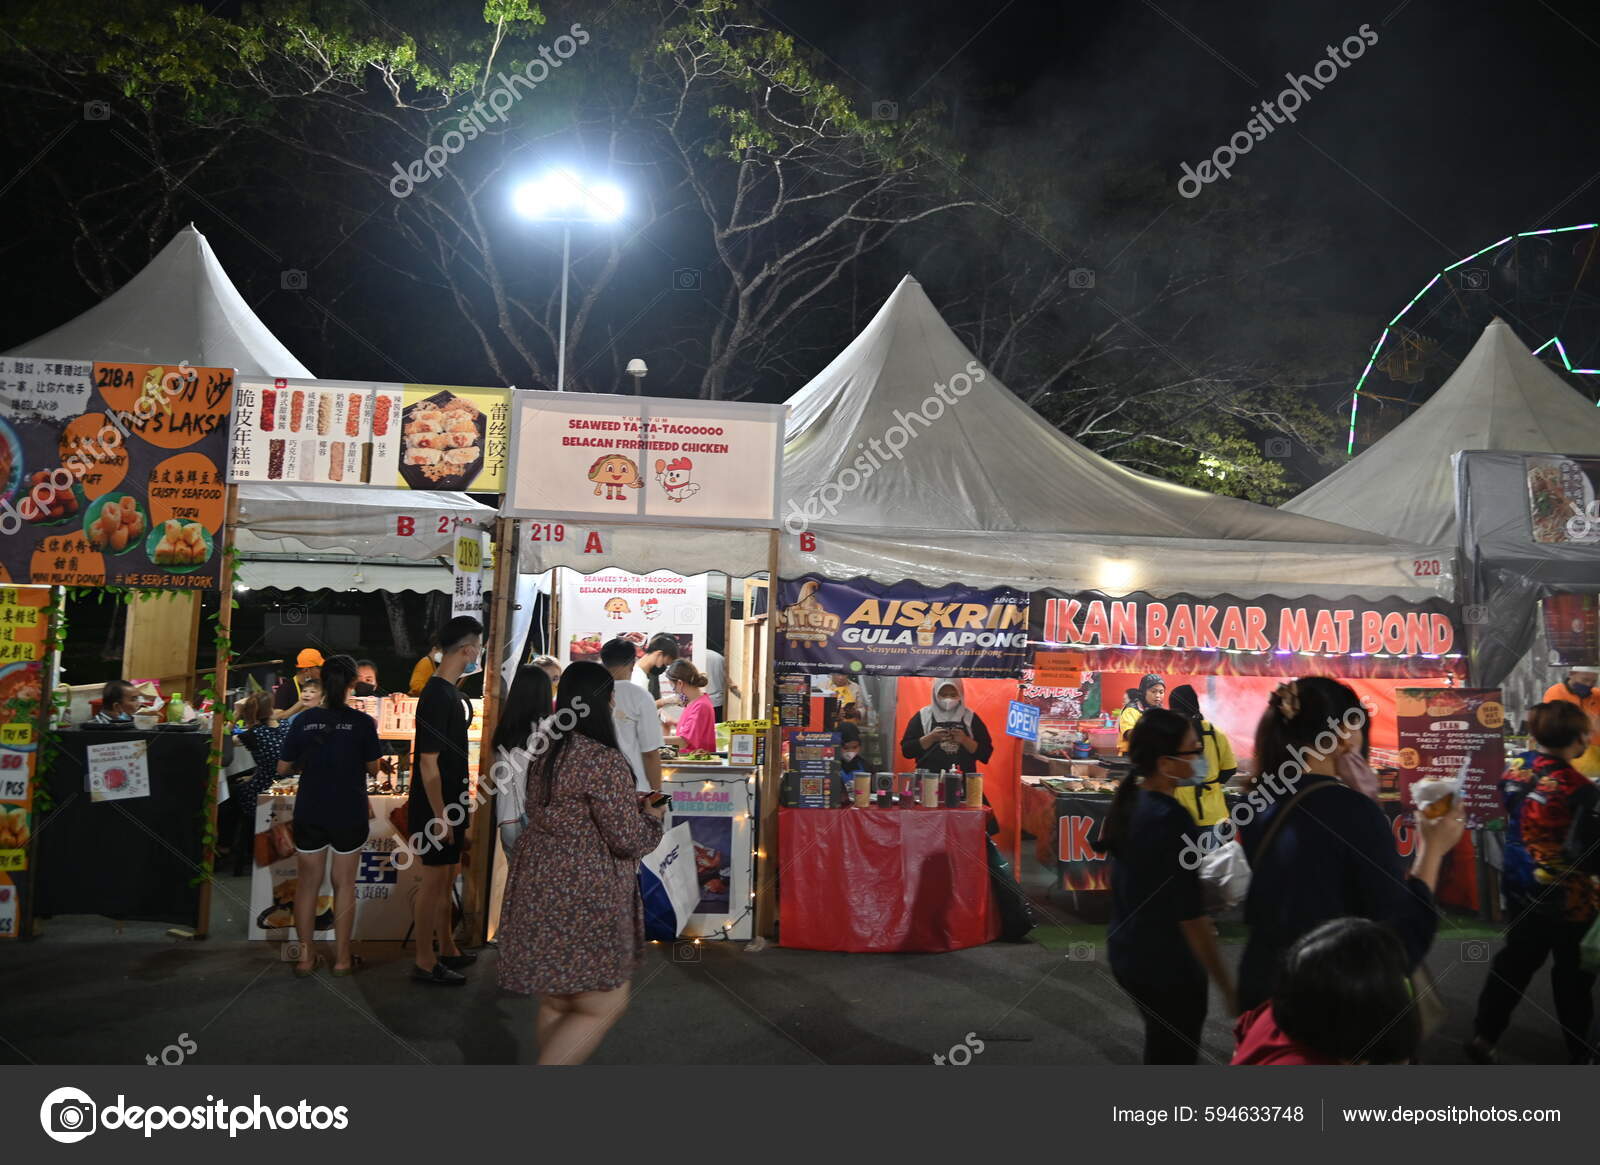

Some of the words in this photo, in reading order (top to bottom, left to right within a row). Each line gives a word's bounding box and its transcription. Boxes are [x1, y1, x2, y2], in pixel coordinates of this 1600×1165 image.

[169, 412, 228, 436] LAKSA
[232, 388, 256, 465] 脆皮年糕
[569, 419, 621, 432] SEAWEED
[562, 436, 614, 448] BELACAN
[681, 443, 729, 455] CHICKEN
[152, 487, 181, 499] CRISPY
[182, 488, 222, 500] SEAFOOD
[396, 516, 415, 537] B
[530, 522, 565, 543] 219
[583, 531, 604, 554] A
[799, 532, 817, 553] B
[1413, 559, 1441, 577] 220
[125, 573, 140, 585] WE
[141, 574, 170, 586] SERVE
[171, 575, 187, 587] NO
[188, 576, 213, 588] PORK
[583, 575, 617, 583] SEAWEED
[579, 586, 612, 595] BELACAN
[844, 599, 1028, 630] AISKRIM
[1043, 598, 1137, 645] IKAN
[1146, 602, 1271, 652] BAKAR
[1279, 607, 1353, 653] MAT
[1362, 610, 1454, 656] BOND
[841, 628, 913, 646] GULA
[936, 631, 1028, 649] APONG
[866, 645, 907, 656] Senyum
[910, 646, 953, 656] Semanis
[955, 647, 1003, 658] Gulapong
[1009, 710, 1037, 733] OPEN
[19, 729, 29, 740] ME
[6, 781, 25, 796] PCS
[672, 791, 729, 803] BELACAN
[1058, 815, 1107, 862] IK
